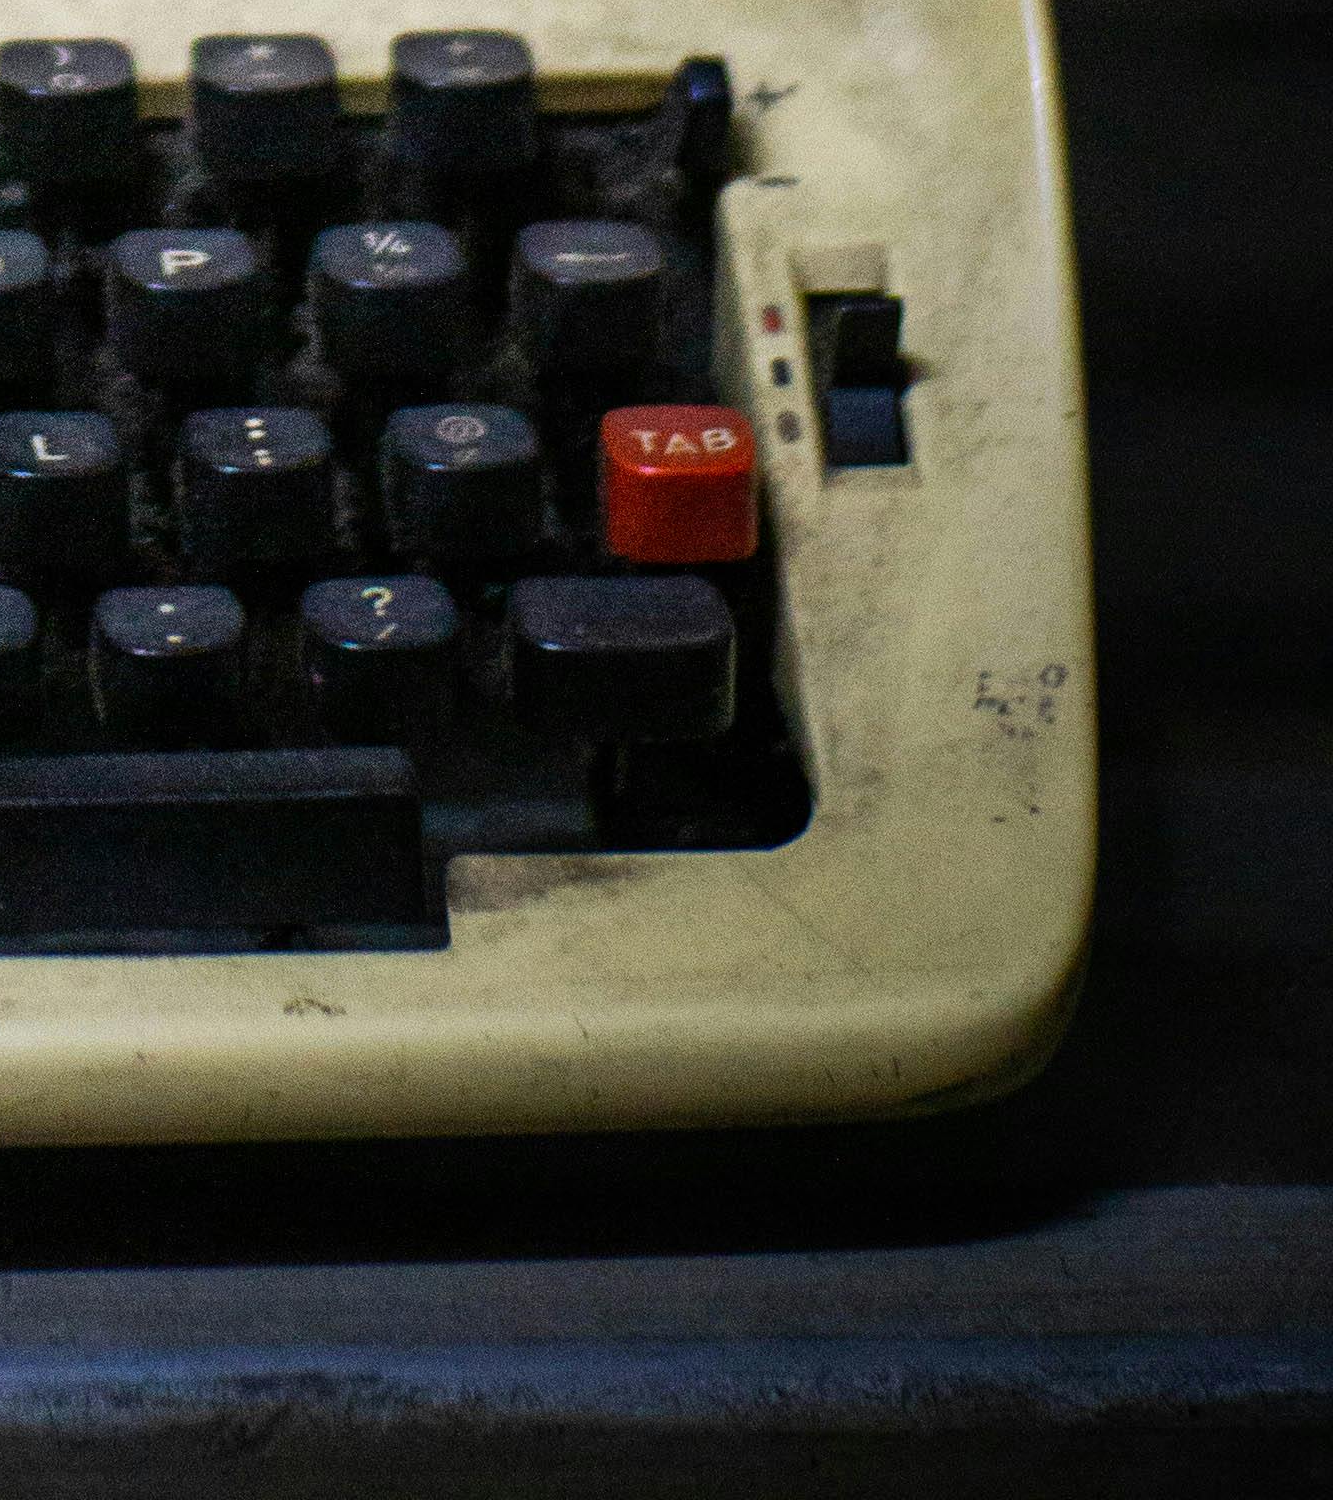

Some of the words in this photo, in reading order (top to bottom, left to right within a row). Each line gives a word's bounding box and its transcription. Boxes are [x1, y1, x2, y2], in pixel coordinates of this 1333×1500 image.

[159, 249, 208, 276] P
[31, 433, 73, 462] L
[629, 426, 737, 456] TAB
[361, 585, 394, 618] ?
